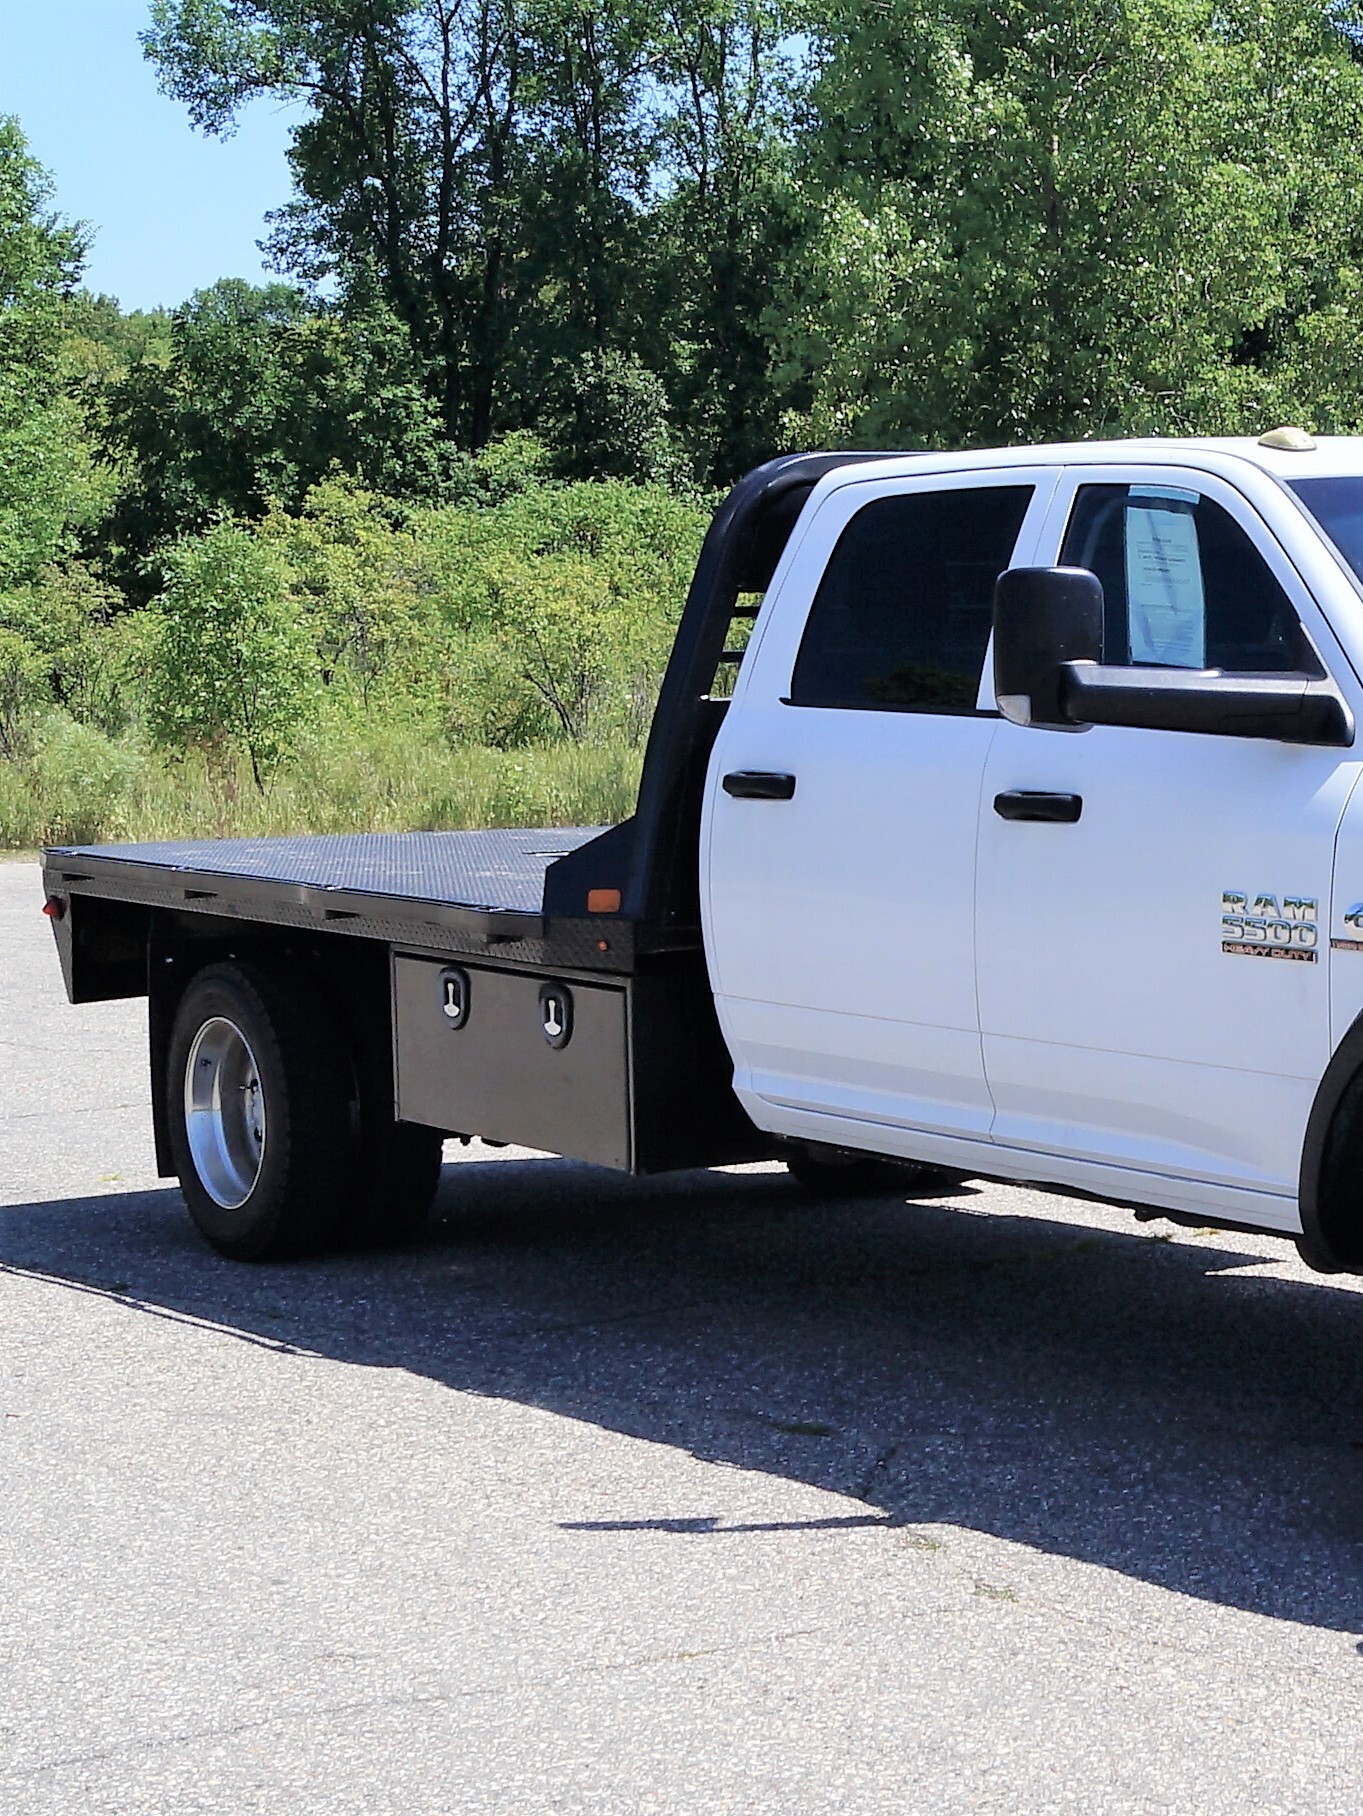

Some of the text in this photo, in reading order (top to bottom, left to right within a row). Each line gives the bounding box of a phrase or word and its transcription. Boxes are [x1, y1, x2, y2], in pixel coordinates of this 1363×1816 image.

[1221, 890, 1318, 921] RAM
[1221, 915, 1317, 948] 5500
[1224, 942, 1312, 961] HEAVY DUTY
